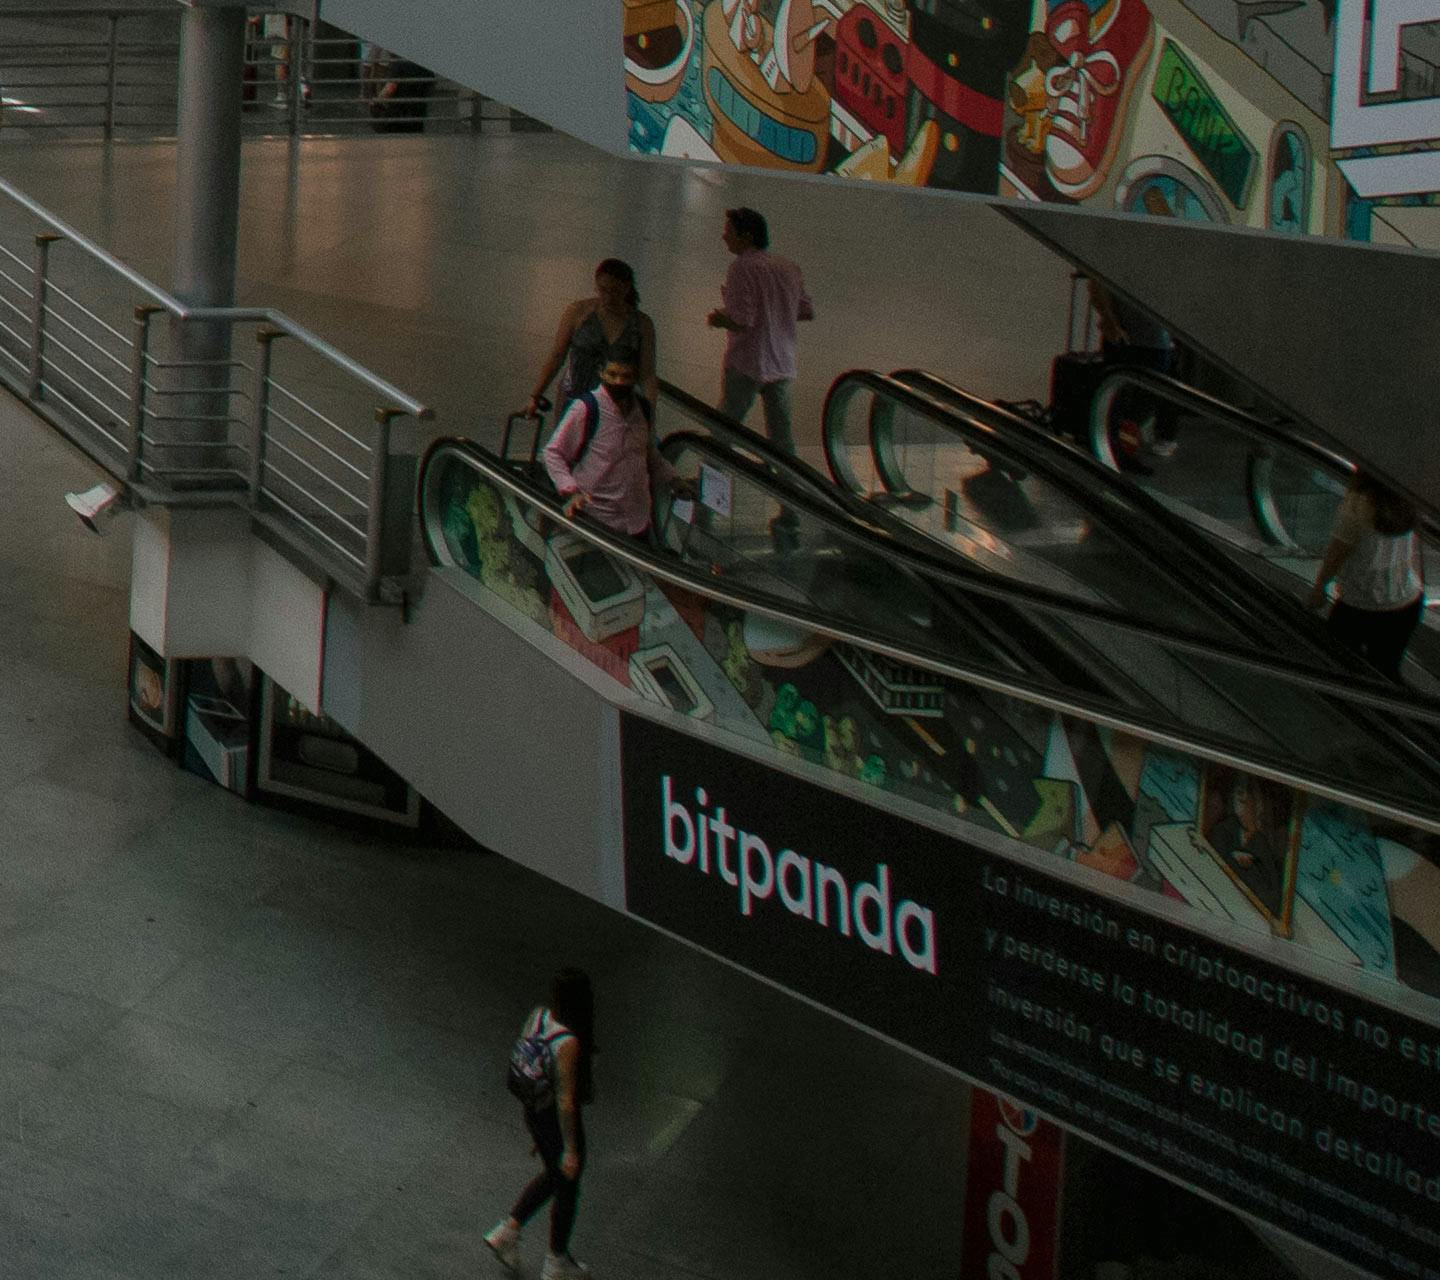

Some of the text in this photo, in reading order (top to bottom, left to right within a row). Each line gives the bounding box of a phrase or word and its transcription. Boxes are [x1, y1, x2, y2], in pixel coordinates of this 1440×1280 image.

[660, 774, 941, 976] bitpanda
[981, 864, 1008, 896] La
[1014, 878, 1120, 941] inversión
[1125, 927, 1156, 955] en
[1162, 941, 1345, 1032] criptoactivos
[1353, 1012, 1391, 1049] no
[989, 979, 1091, 1045] inversión
[1099, 1031, 1145, 1069] que
[1151, 1052, 1180, 1081] se
[1187, 1071, 1305, 1139] explican
[1002, 935, 1106, 992] perderse
[1112, 974, 1136, 1007] la
[1141, 989, 1265, 1060] totalidad
[1273, 1041, 1317, 1083] del
